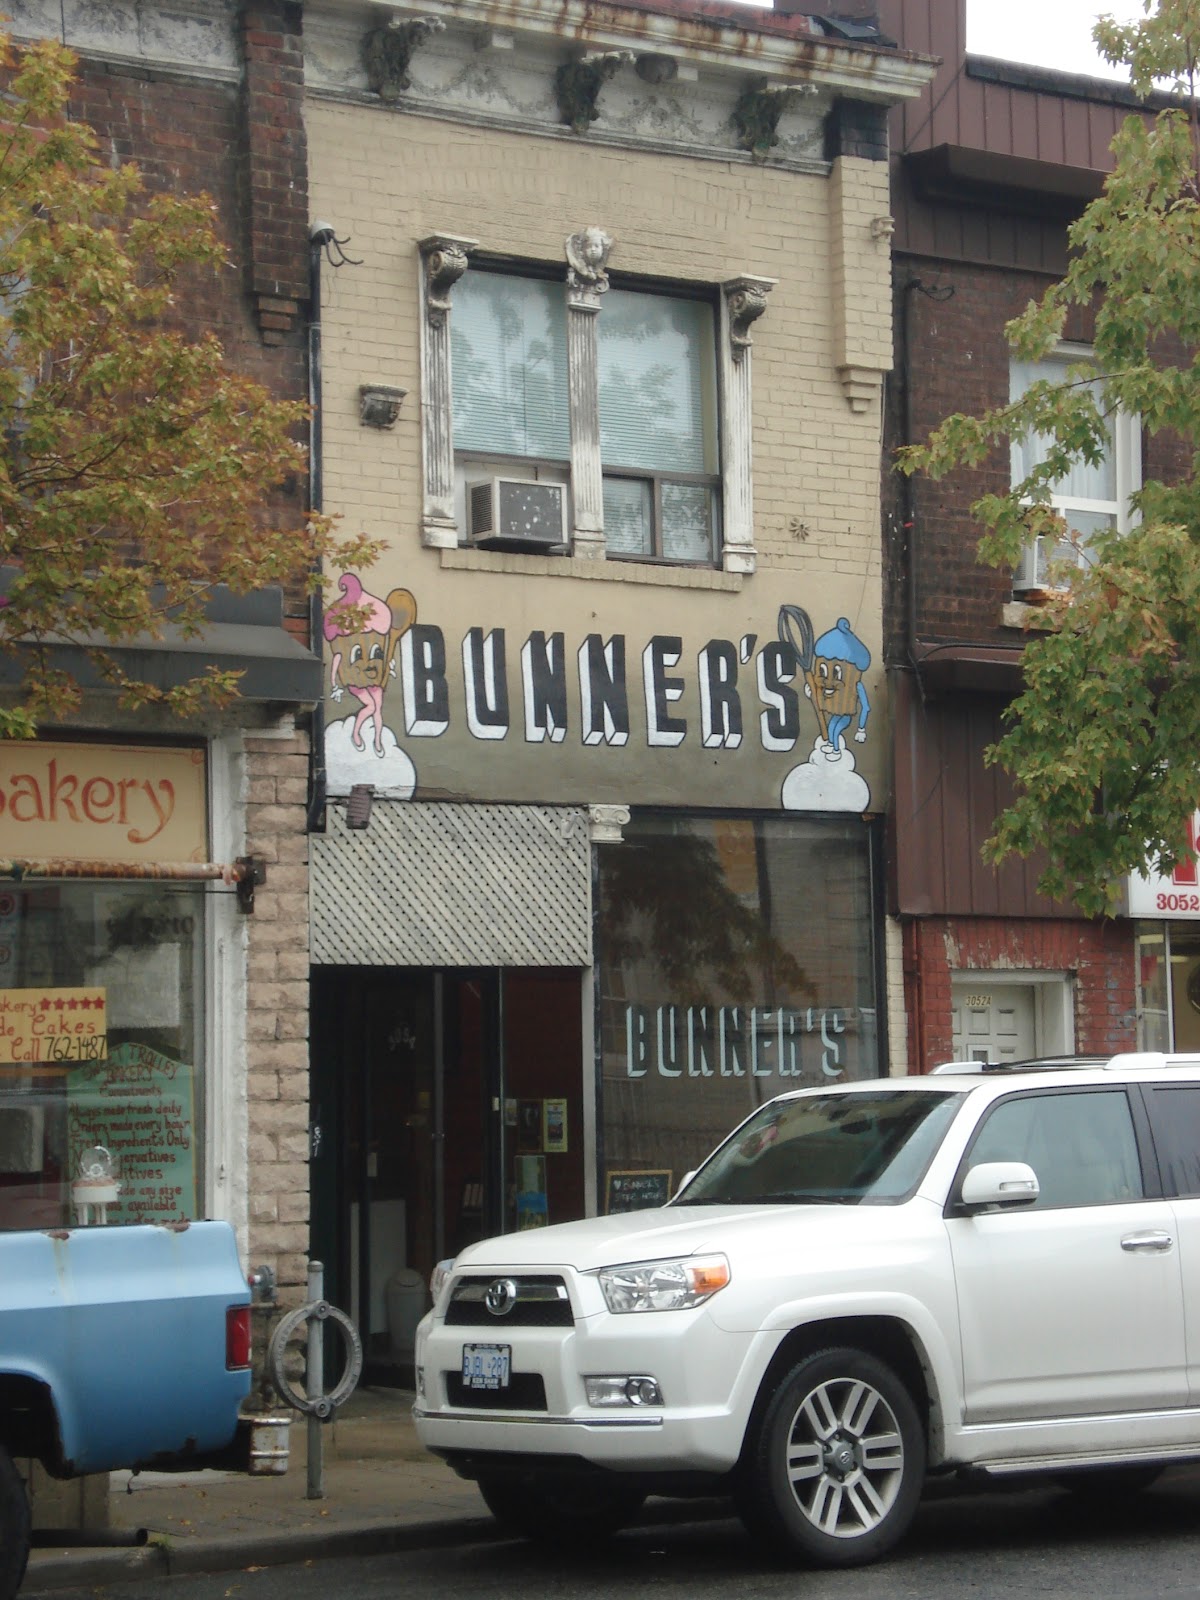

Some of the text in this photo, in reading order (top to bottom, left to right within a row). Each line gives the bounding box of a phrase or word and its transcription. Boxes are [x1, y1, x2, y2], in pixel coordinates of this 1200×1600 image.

[402, 624, 798, 752] BUNNER'S
[0, 758, 175, 844] akery
[1156, 893, 1200, 912] 3052
[966, 995, 991, 1006] 3052A
[32, 1014, 96, 1035] Cakes
[11, 1035, 106, 1061] Call 762-1487
[626, 1006, 846, 1077] BUNNER'S
